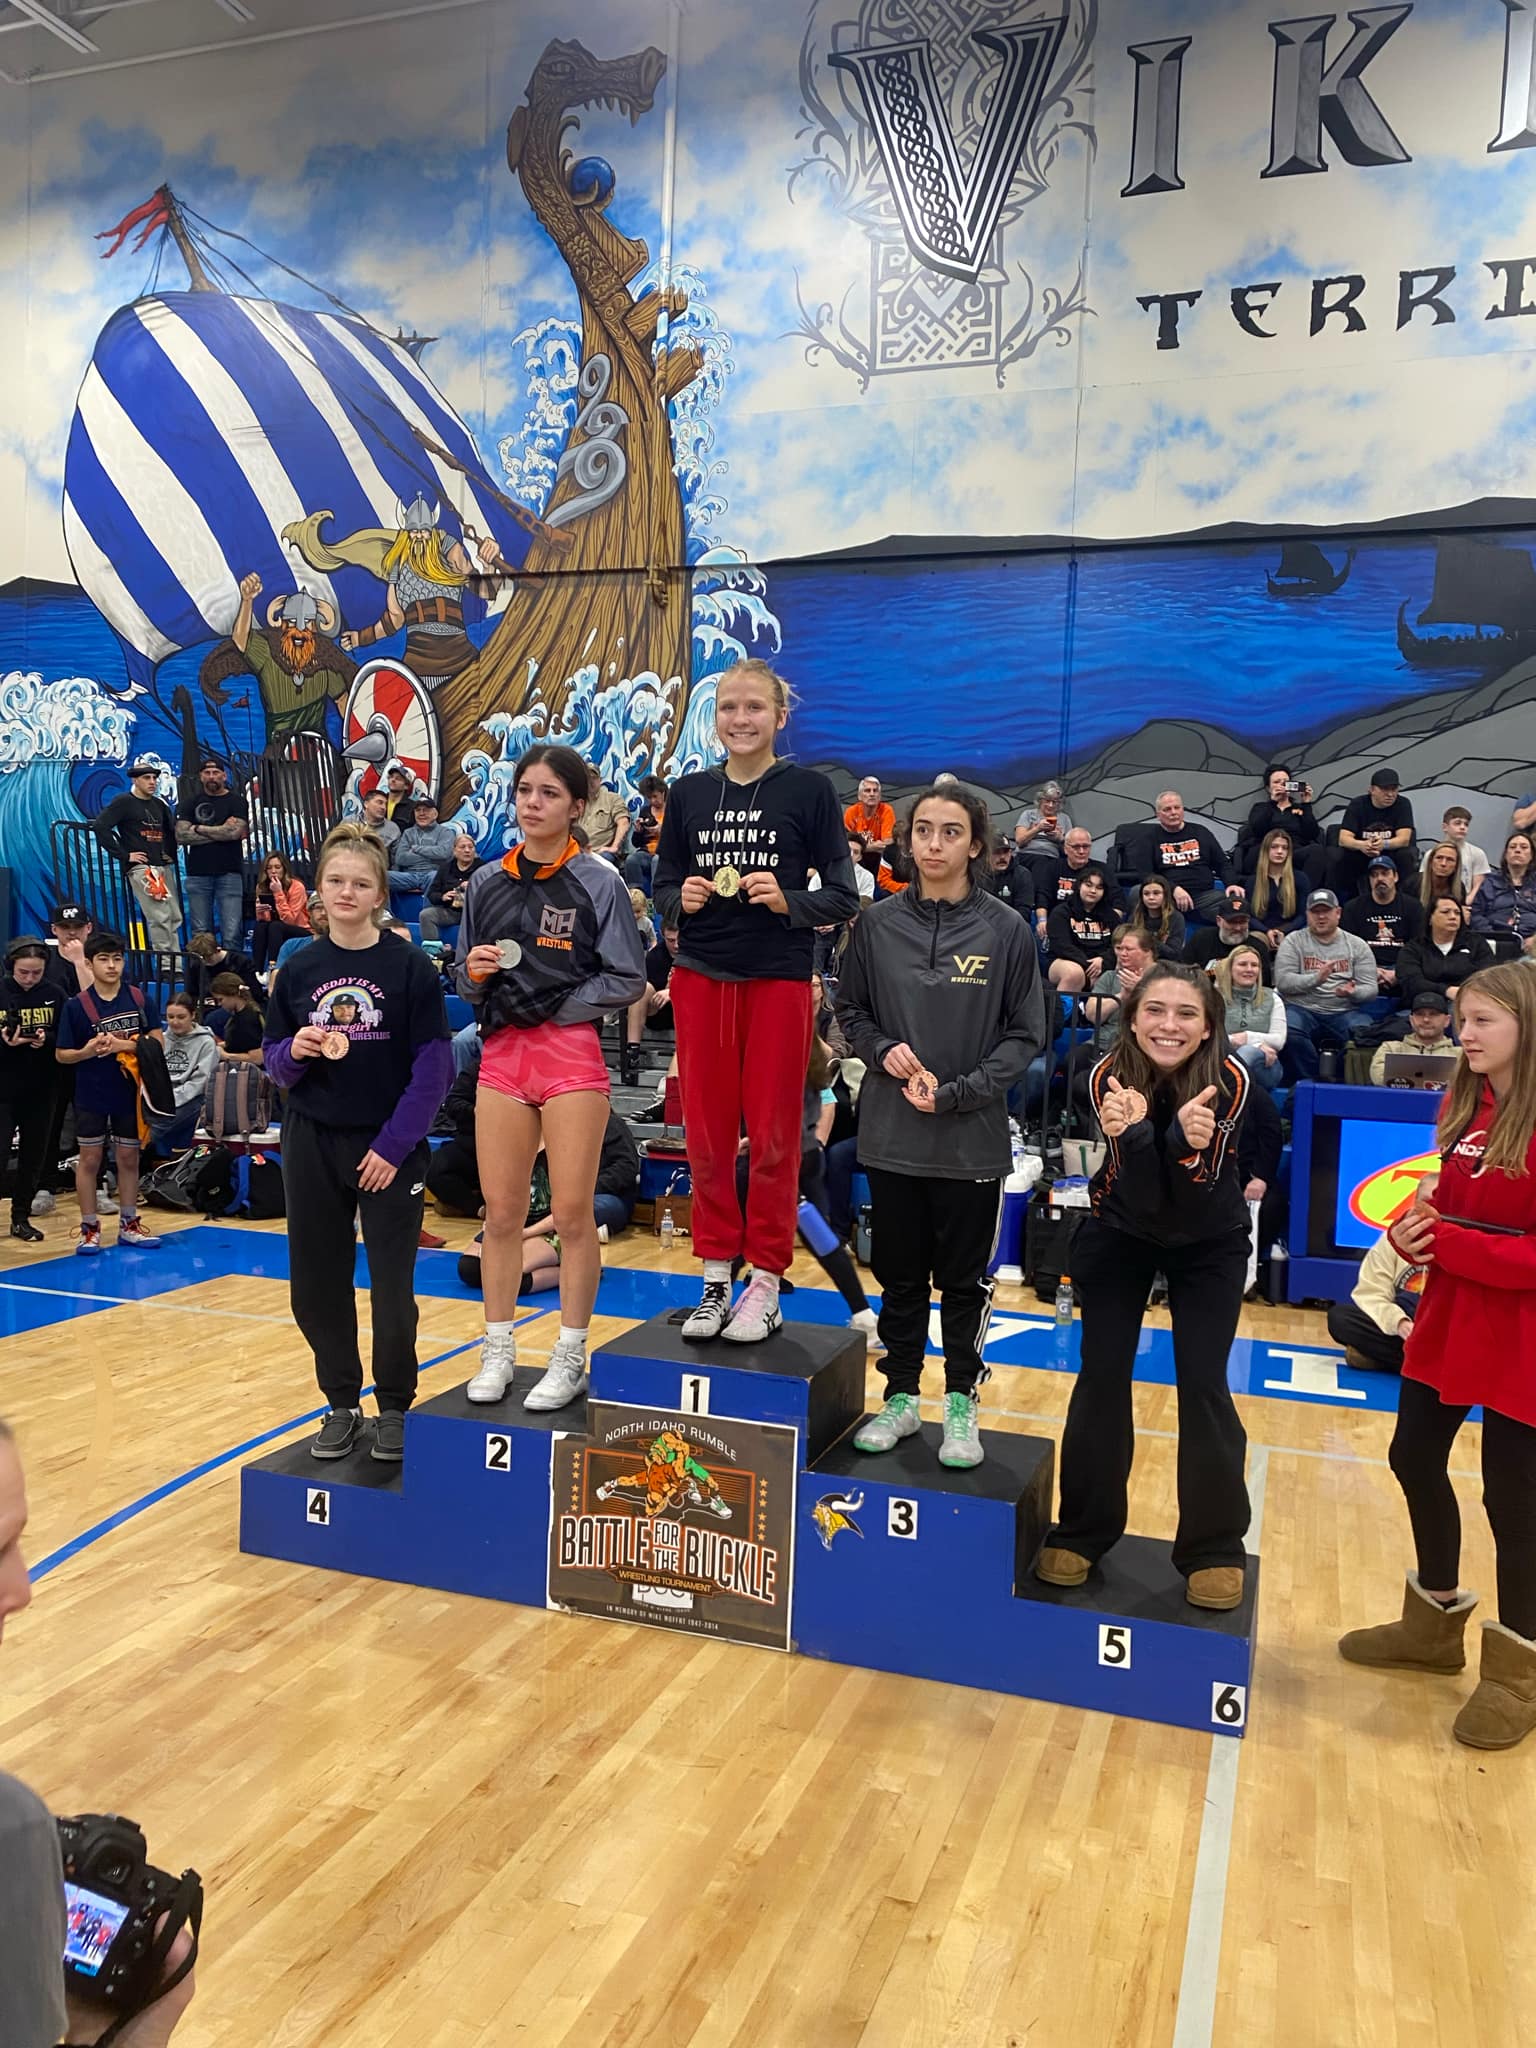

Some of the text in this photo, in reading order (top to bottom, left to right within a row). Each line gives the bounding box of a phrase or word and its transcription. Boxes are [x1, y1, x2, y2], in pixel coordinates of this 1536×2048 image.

[1136, 257, 1536, 350] TERRI
[714, 809, 763, 823] GROW
[697, 828, 778, 845] WOMEN'S
[695, 851, 780, 867] WRESTLING
[536, 936, 574, 951] WRESTLING
[952, 954, 991, 977] VF
[311, 976, 385, 1002] FREDDY IS MY
[689, 1378, 701, 1413] 1
[488, 1435, 509, 1469] 2
[605, 1420, 738, 1462] NORTH IDAHO RUMBLE
[308, 1491, 328, 1523] 4
[891, 1500, 914, 1536] 3
[559, 1515, 651, 1569] BATTLE
[653, 1520, 681, 1548] FOR
[653, 1548, 680, 1575] THE
[683, 1526, 778, 1605] BUCKLE
[618, 1569, 661, 1585] WRESTLING
[662, 1575, 712, 1593] TOURNAMENT
[1103, 1627, 1127, 1664] 5
[1215, 1685, 1242, 1723] 6
